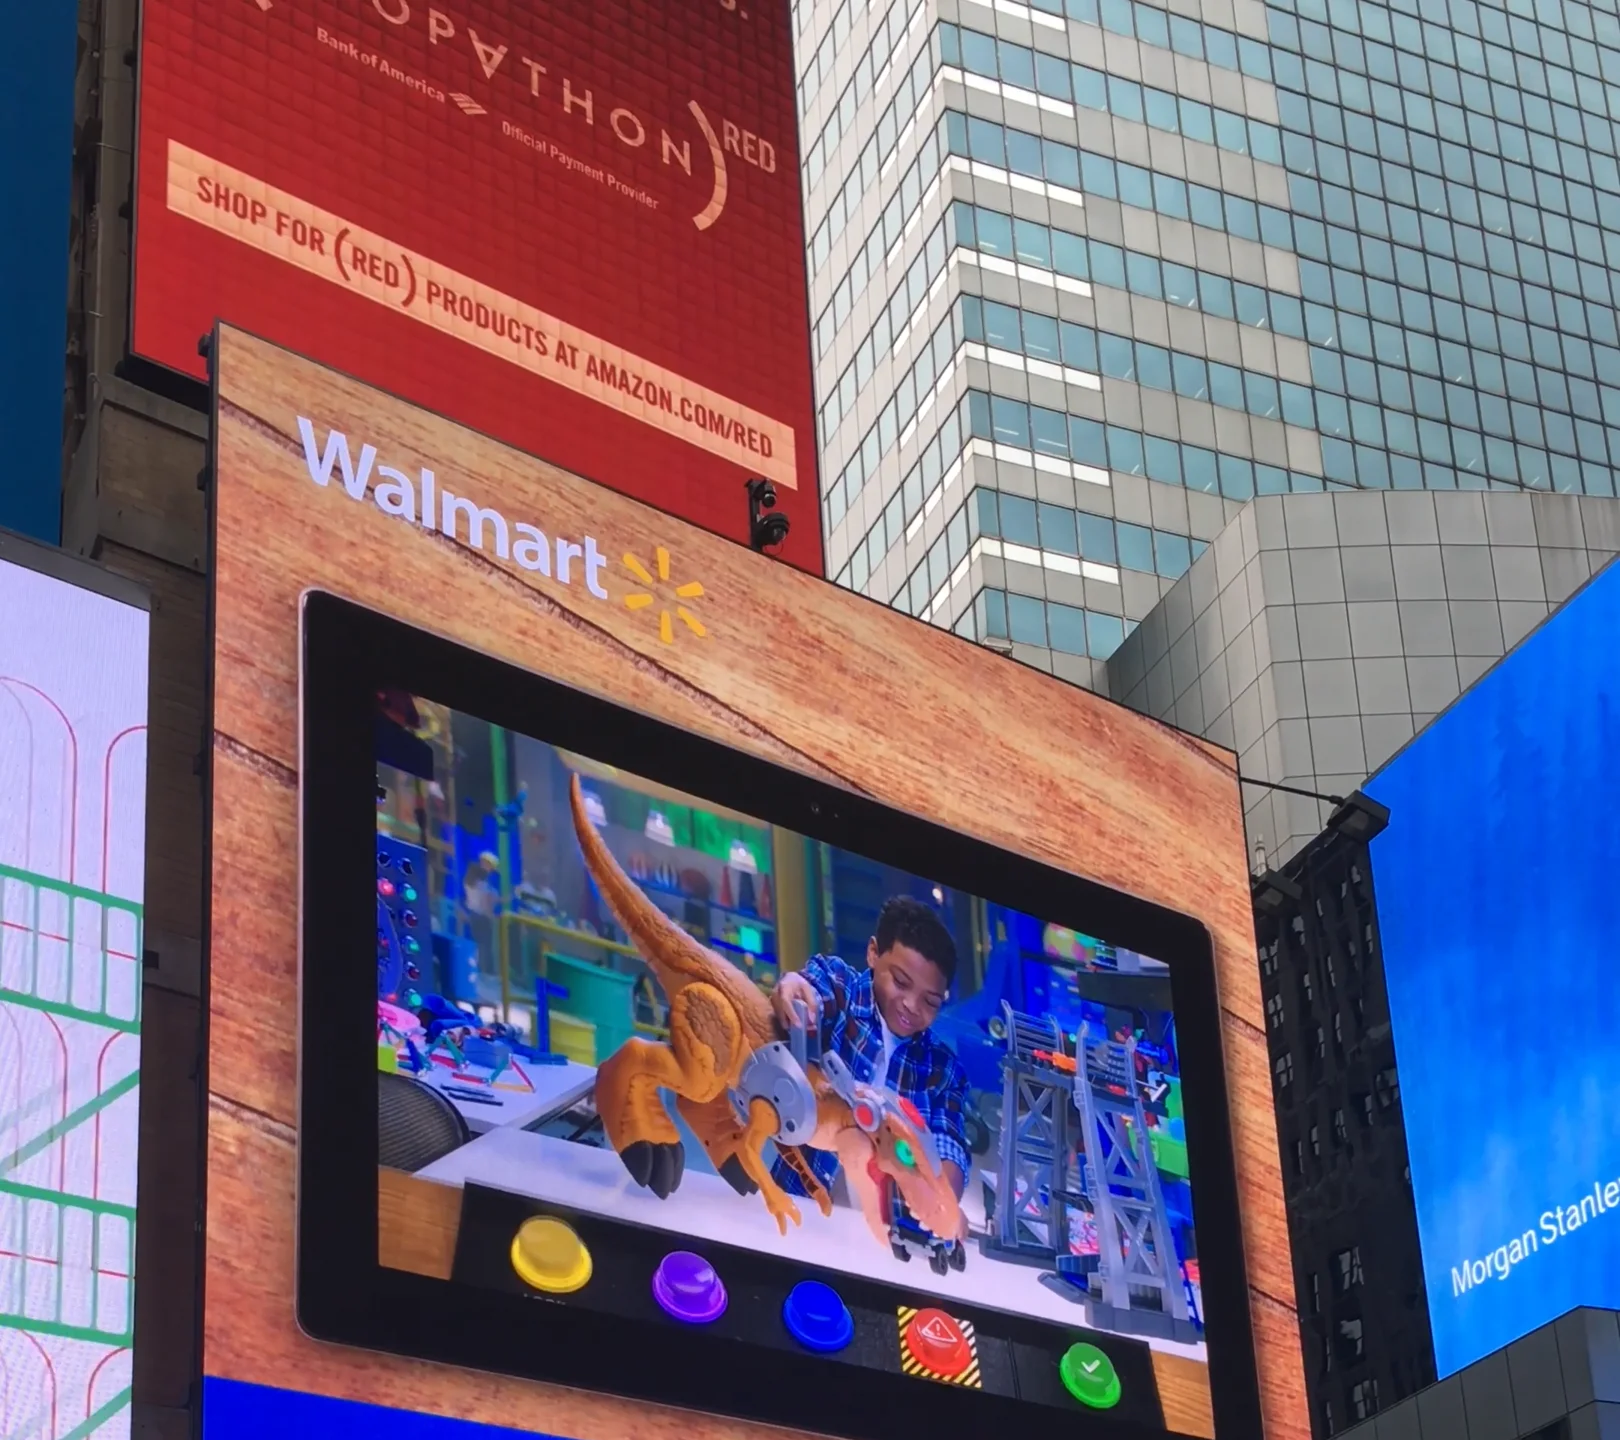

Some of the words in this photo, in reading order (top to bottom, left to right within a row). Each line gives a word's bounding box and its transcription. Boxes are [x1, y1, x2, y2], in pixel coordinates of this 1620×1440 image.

[317, 26, 359, 61] Bank
[360, 52, 378, 68] of
[379, 59, 445, 103] America
[502, 120, 547, 154] Official
[550, 144, 604, 184] Payment
[607, 174, 659, 210] Provider
[197, 176, 267, 225] SHOP
[276, 211, 325, 256] FOR
[334, 227, 416, 307] (RED)
[426, 279, 548, 356] PRODUCTS
[555, 339, 580, 370] AT
[586, 354, 773, 459] AMAZON.COM/RED
[297, 415, 608, 600] Walmart
[1451, 1229, 1539, 1298] Morgan
[1539, 1176, 1620, 1245] Stanle
